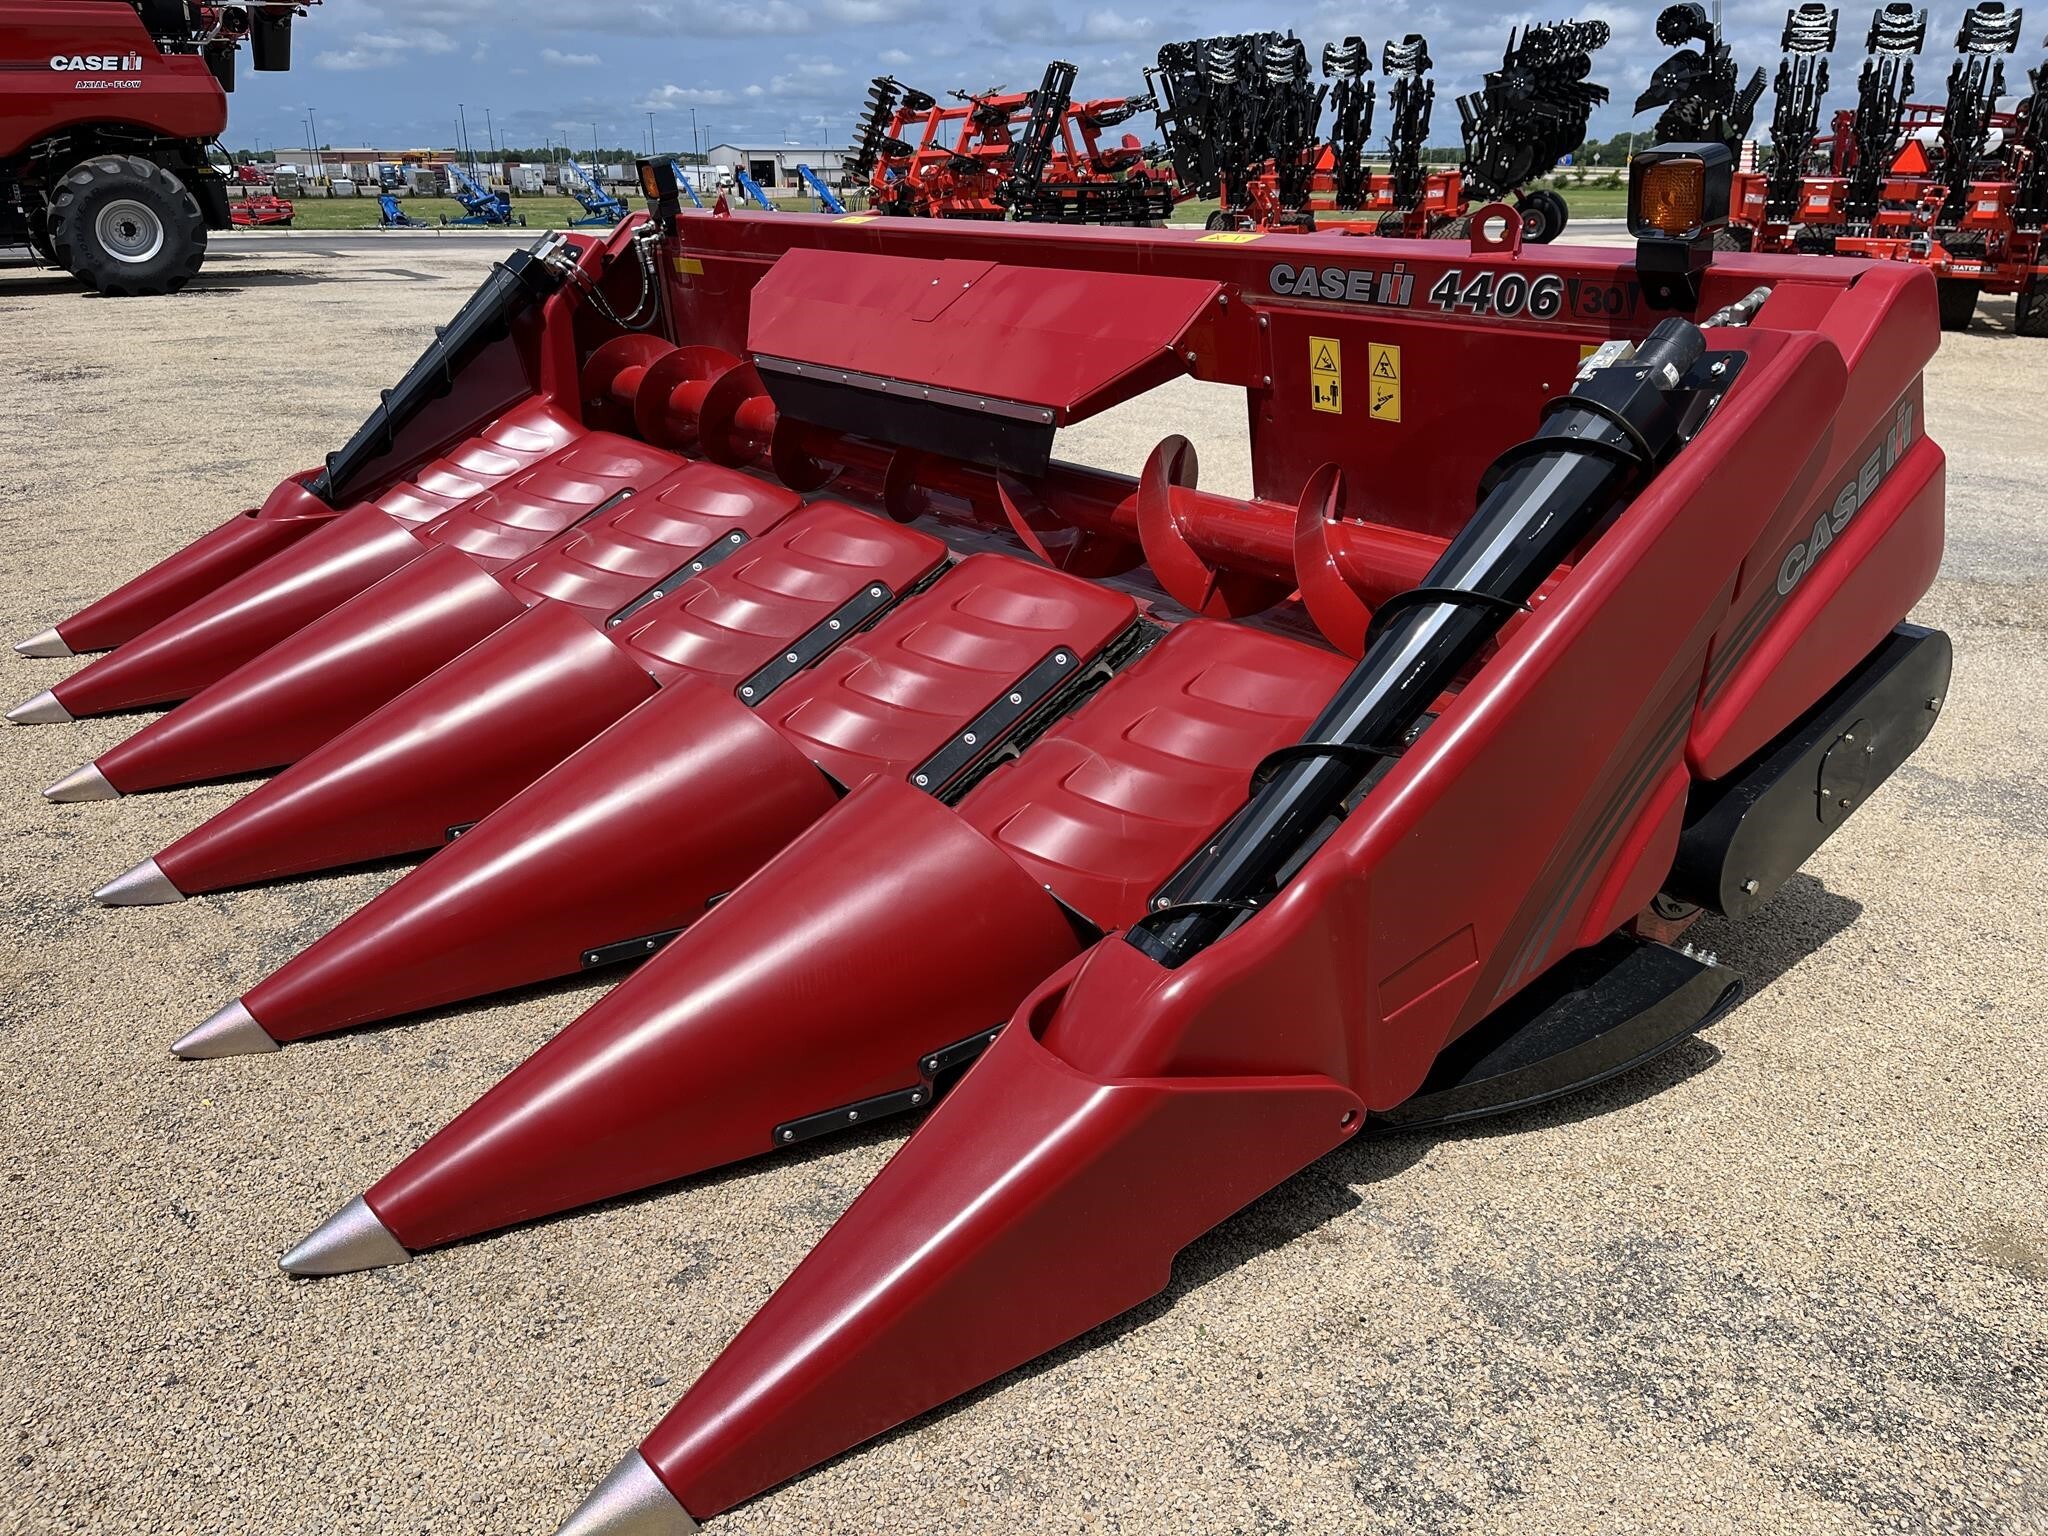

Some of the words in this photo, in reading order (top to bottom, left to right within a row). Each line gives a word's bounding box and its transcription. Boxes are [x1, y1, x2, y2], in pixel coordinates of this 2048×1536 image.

[50, 55, 118, 71] CASE
[75, 80, 142, 89] AXIAL-FLOW
[1269, 263, 1374, 302] CASE
[1429, 269, 1565, 320] 4406
[1583, 286, 1623, 315] 30
[1777, 445, 1881, 595] CASE
